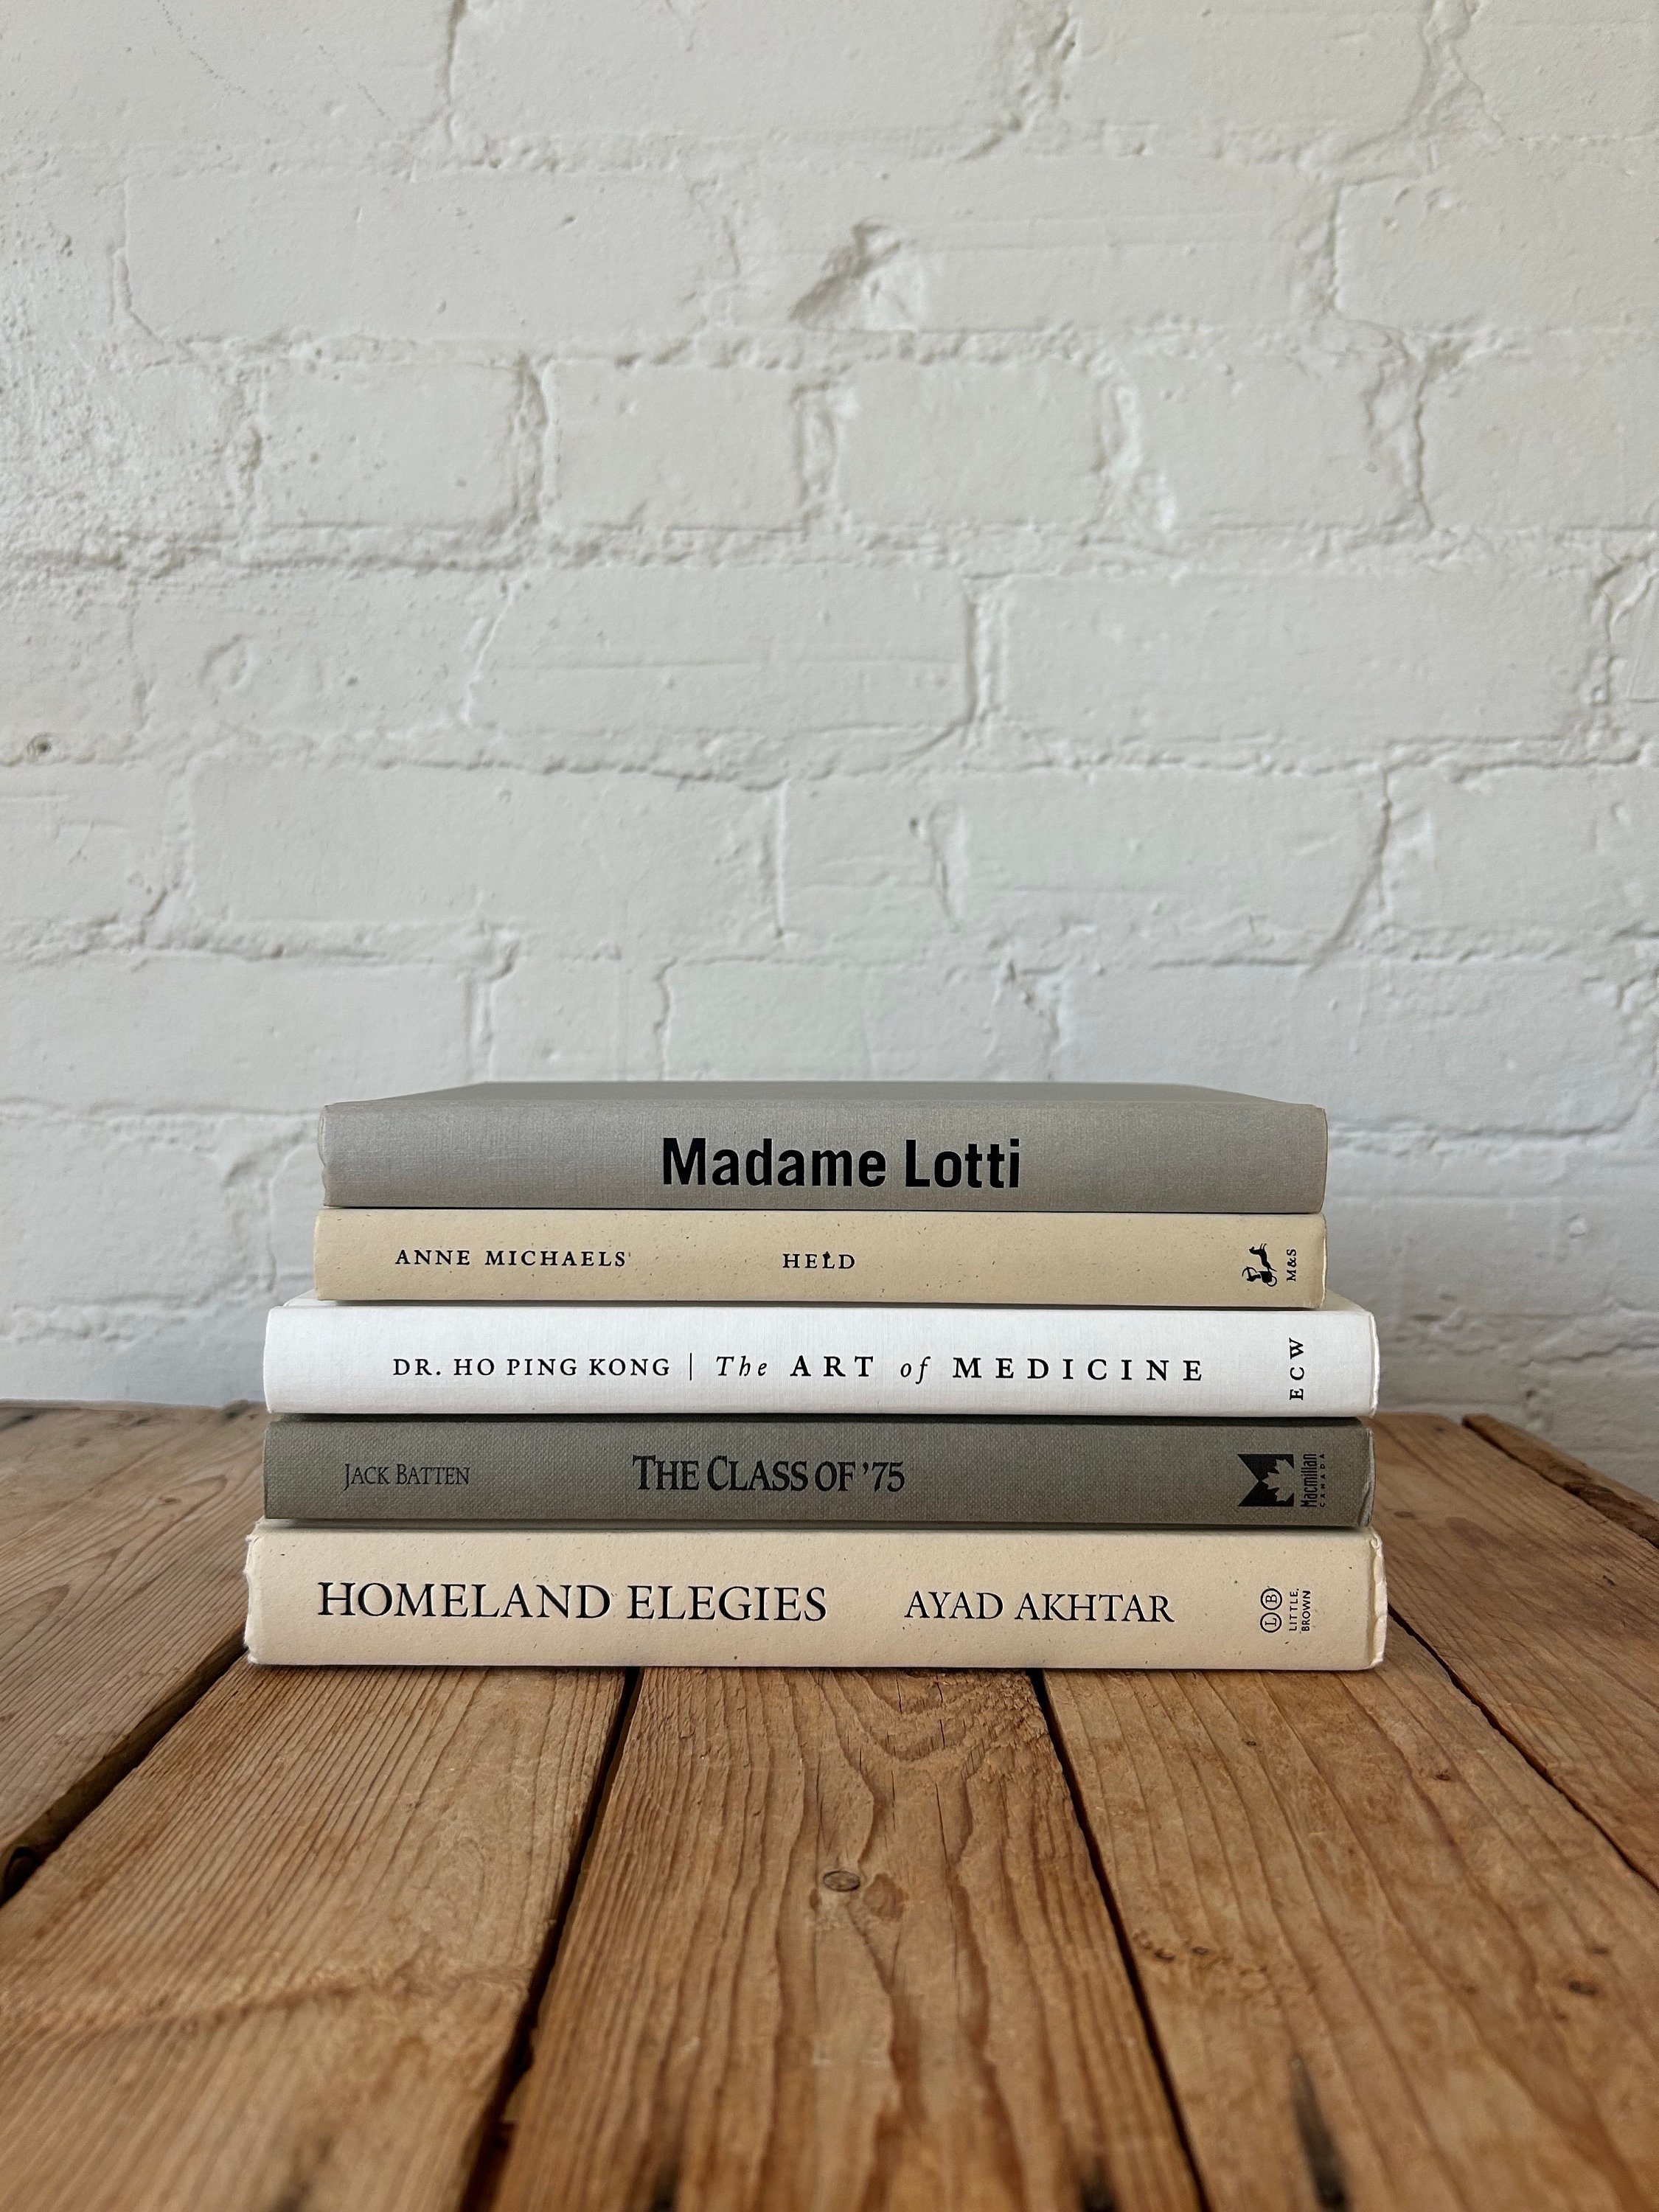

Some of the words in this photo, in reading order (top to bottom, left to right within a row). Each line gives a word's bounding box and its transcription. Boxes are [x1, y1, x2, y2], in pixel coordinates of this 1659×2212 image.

[663, 1137, 886, 1188] Madame
[905, 1138, 1020, 1189] Lotti
[394, 1249, 470, 1266] ANNE
[484, 1250, 625, 1267] MICHAELS
[782, 1251, 855, 1270] HELD
[1286, 1248, 1297, 1282] M&S
[392, 1358, 441, 1376] DR.
[453, 1358, 495, 1376] HO
[507, 1358, 577, 1376] PING
[588, 1358, 669, 1376] KONG
[716, 1355, 768, 1377] The
[790, 1354, 874, 1377] ART
[900, 1355, 931, 1385] of
[952, 1357, 1202, 1382] MEDICINE
[1288, 1337, 1305, 1401] ECW
[343, 1463, 391, 1492] JACK
[395, 1463, 470, 1486] BATTEN
[632, 1454, 700, 1491] THE
[706, 1455, 809, 1492] CLASS
[814, 1461, 856, 1492] OF
[862, 1461, 905, 1493] '75
[1299, 1453, 1318, 1508] Macmillan
[317, 1582, 611, 1619] HOMELAND
[626, 1585, 827, 1622] ELEGIES
[903, 1590, 1004, 1620] AYAD
[1014, 1592, 1175, 1623] AKHTAR
[1288, 1587, 1300, 1632] LITTLE,
[1301, 1590, 1311, 1632] BROWN
